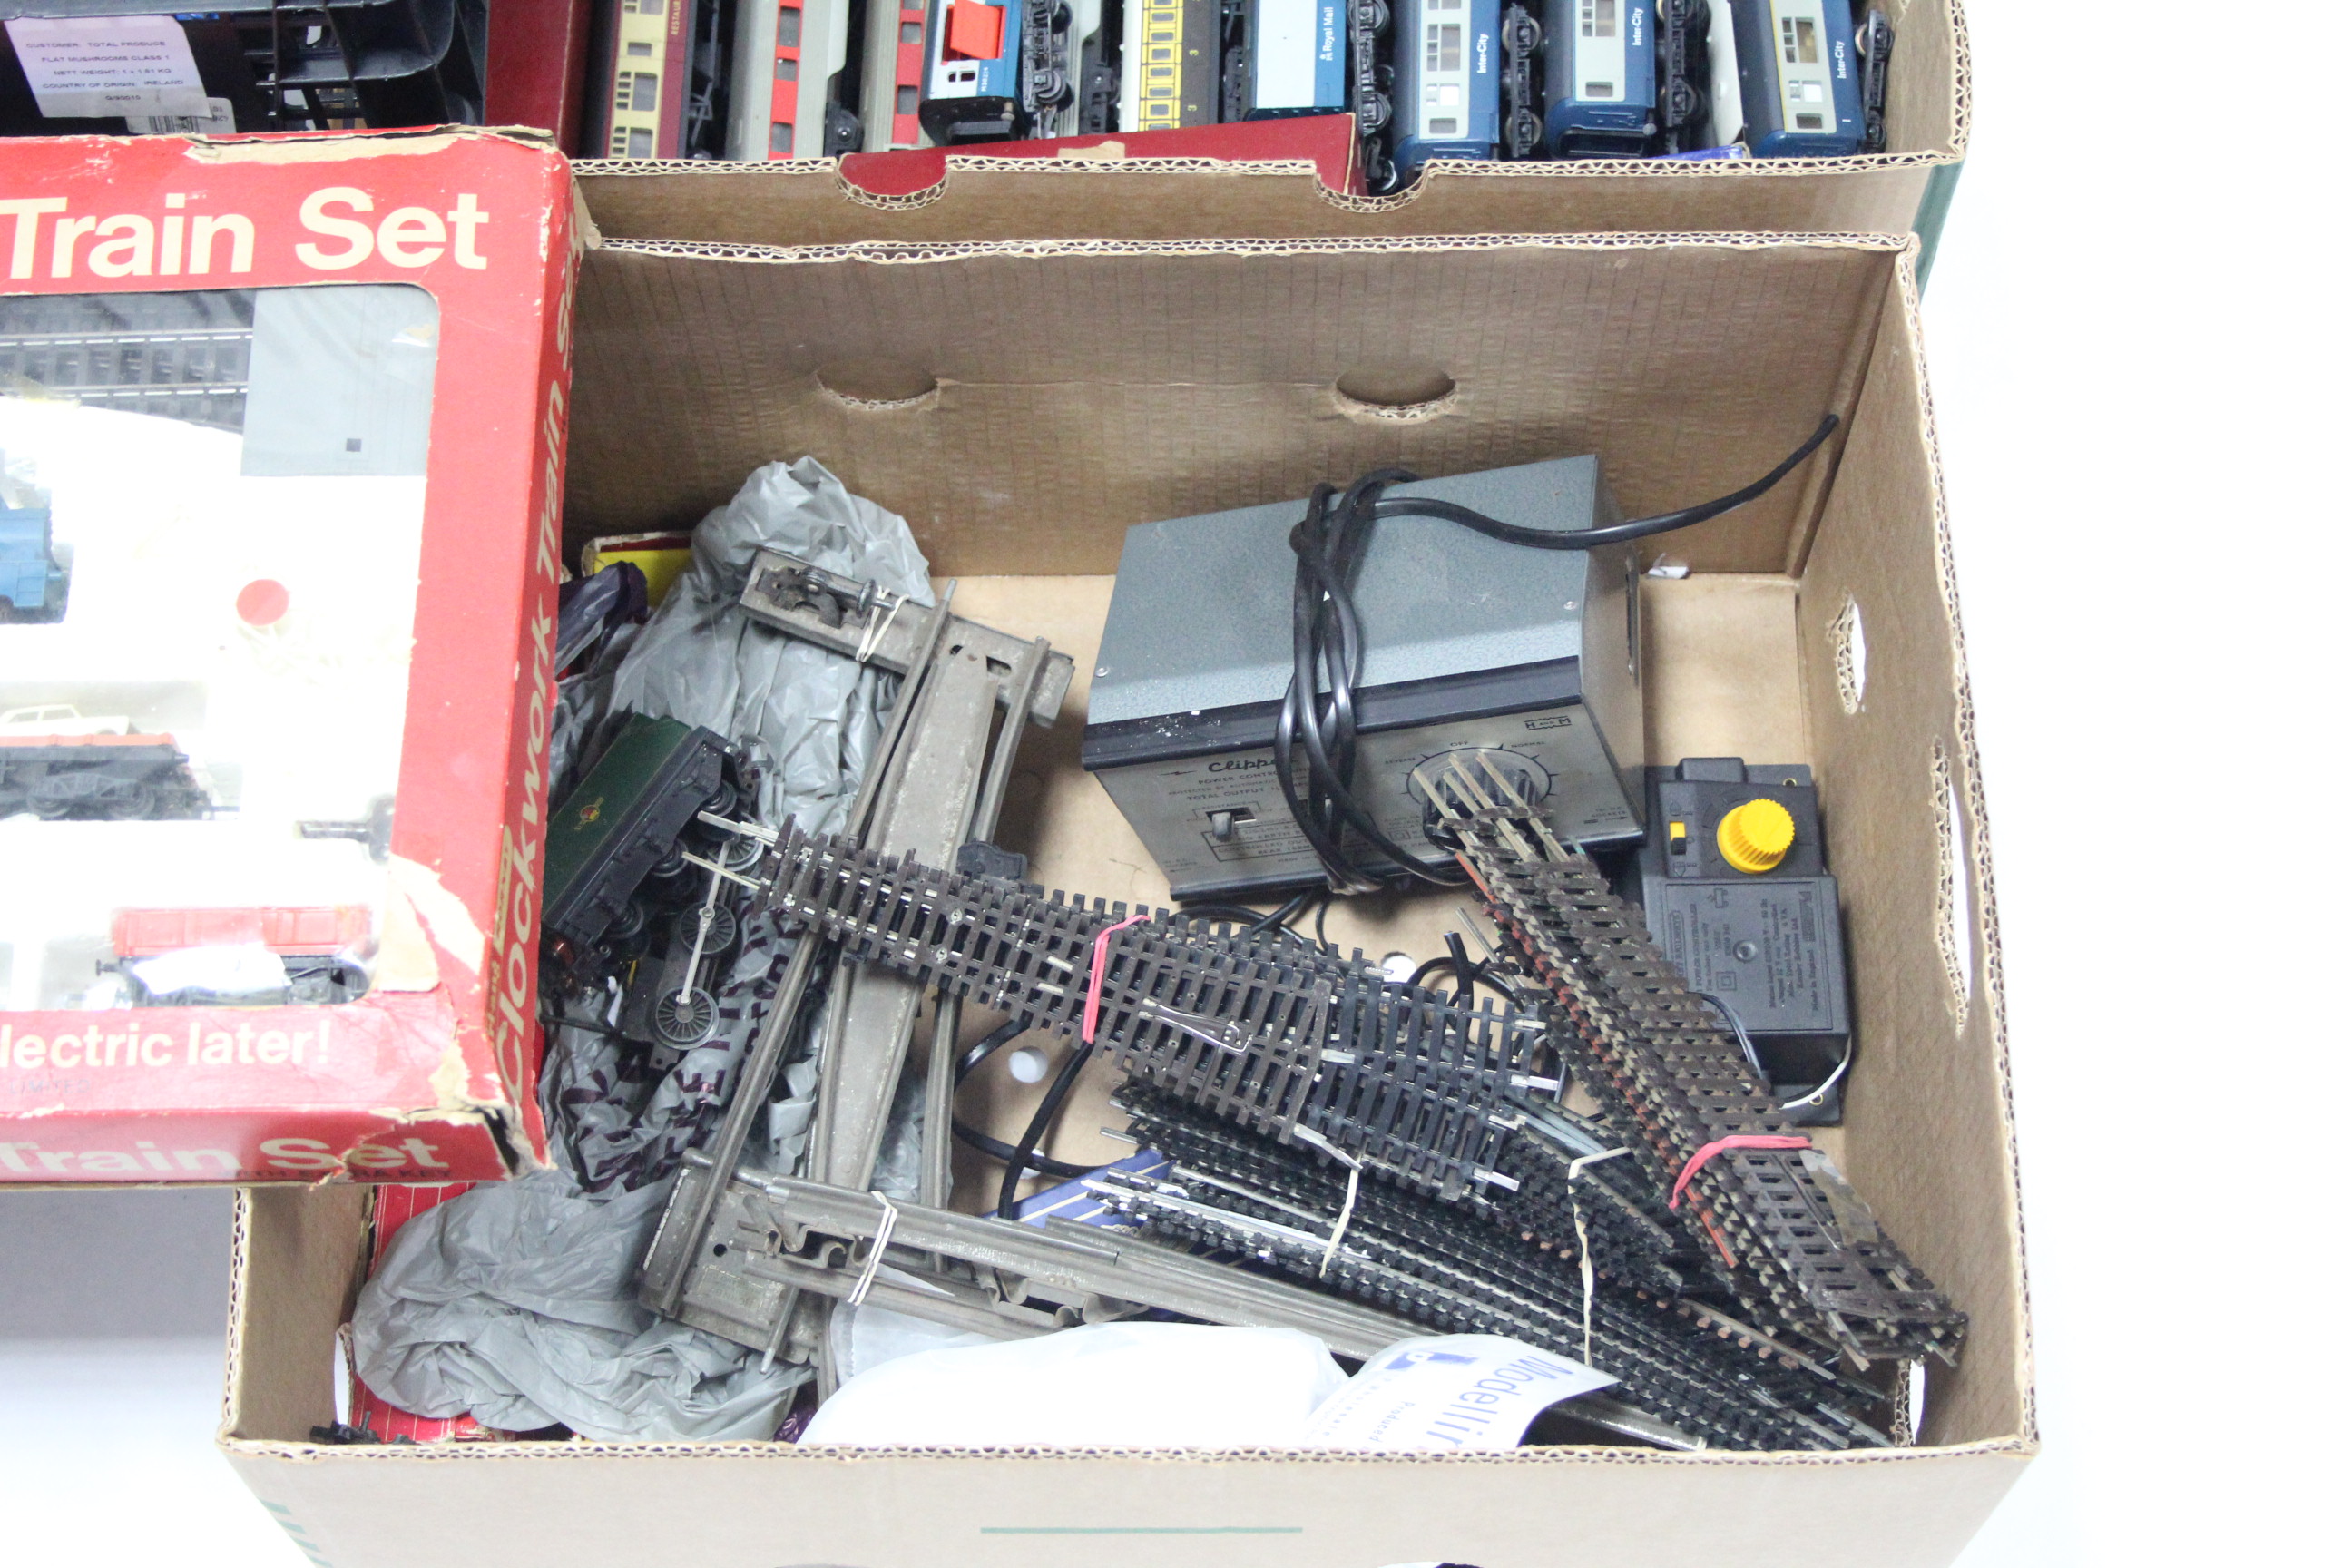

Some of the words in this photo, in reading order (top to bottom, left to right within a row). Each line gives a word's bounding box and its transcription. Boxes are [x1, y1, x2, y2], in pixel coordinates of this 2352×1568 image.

[1323, 6, 1334, 26] Mail
[1632, 7, 1643, 46] Inter-City
[1322, 27, 1335, 52] Royal
[1476, 33, 1489, 74] Inter-City
[1834, 41, 1847, 79] Inter-City
[0, 192, 255, 279] Train
[295, 186, 490, 271] Set
[497, 593, 552, 1101] Clockwork
[536, 379, 564, 585] Train
[1199, 777, 1234, 785] POWER
[1208, 758, 1278, 772] Clipp
[1187, 793, 1219, 801] TOTAL
[1225, 788, 1265, 797] OUTPUT
[0, 1023, 173, 1069] lectric
[187, 1019, 331, 1065] later!
[9, 1079, 91, 1094] LIMITED
[0, 1140, 242, 1173] Train
[259, 1137, 450, 1169] Set
